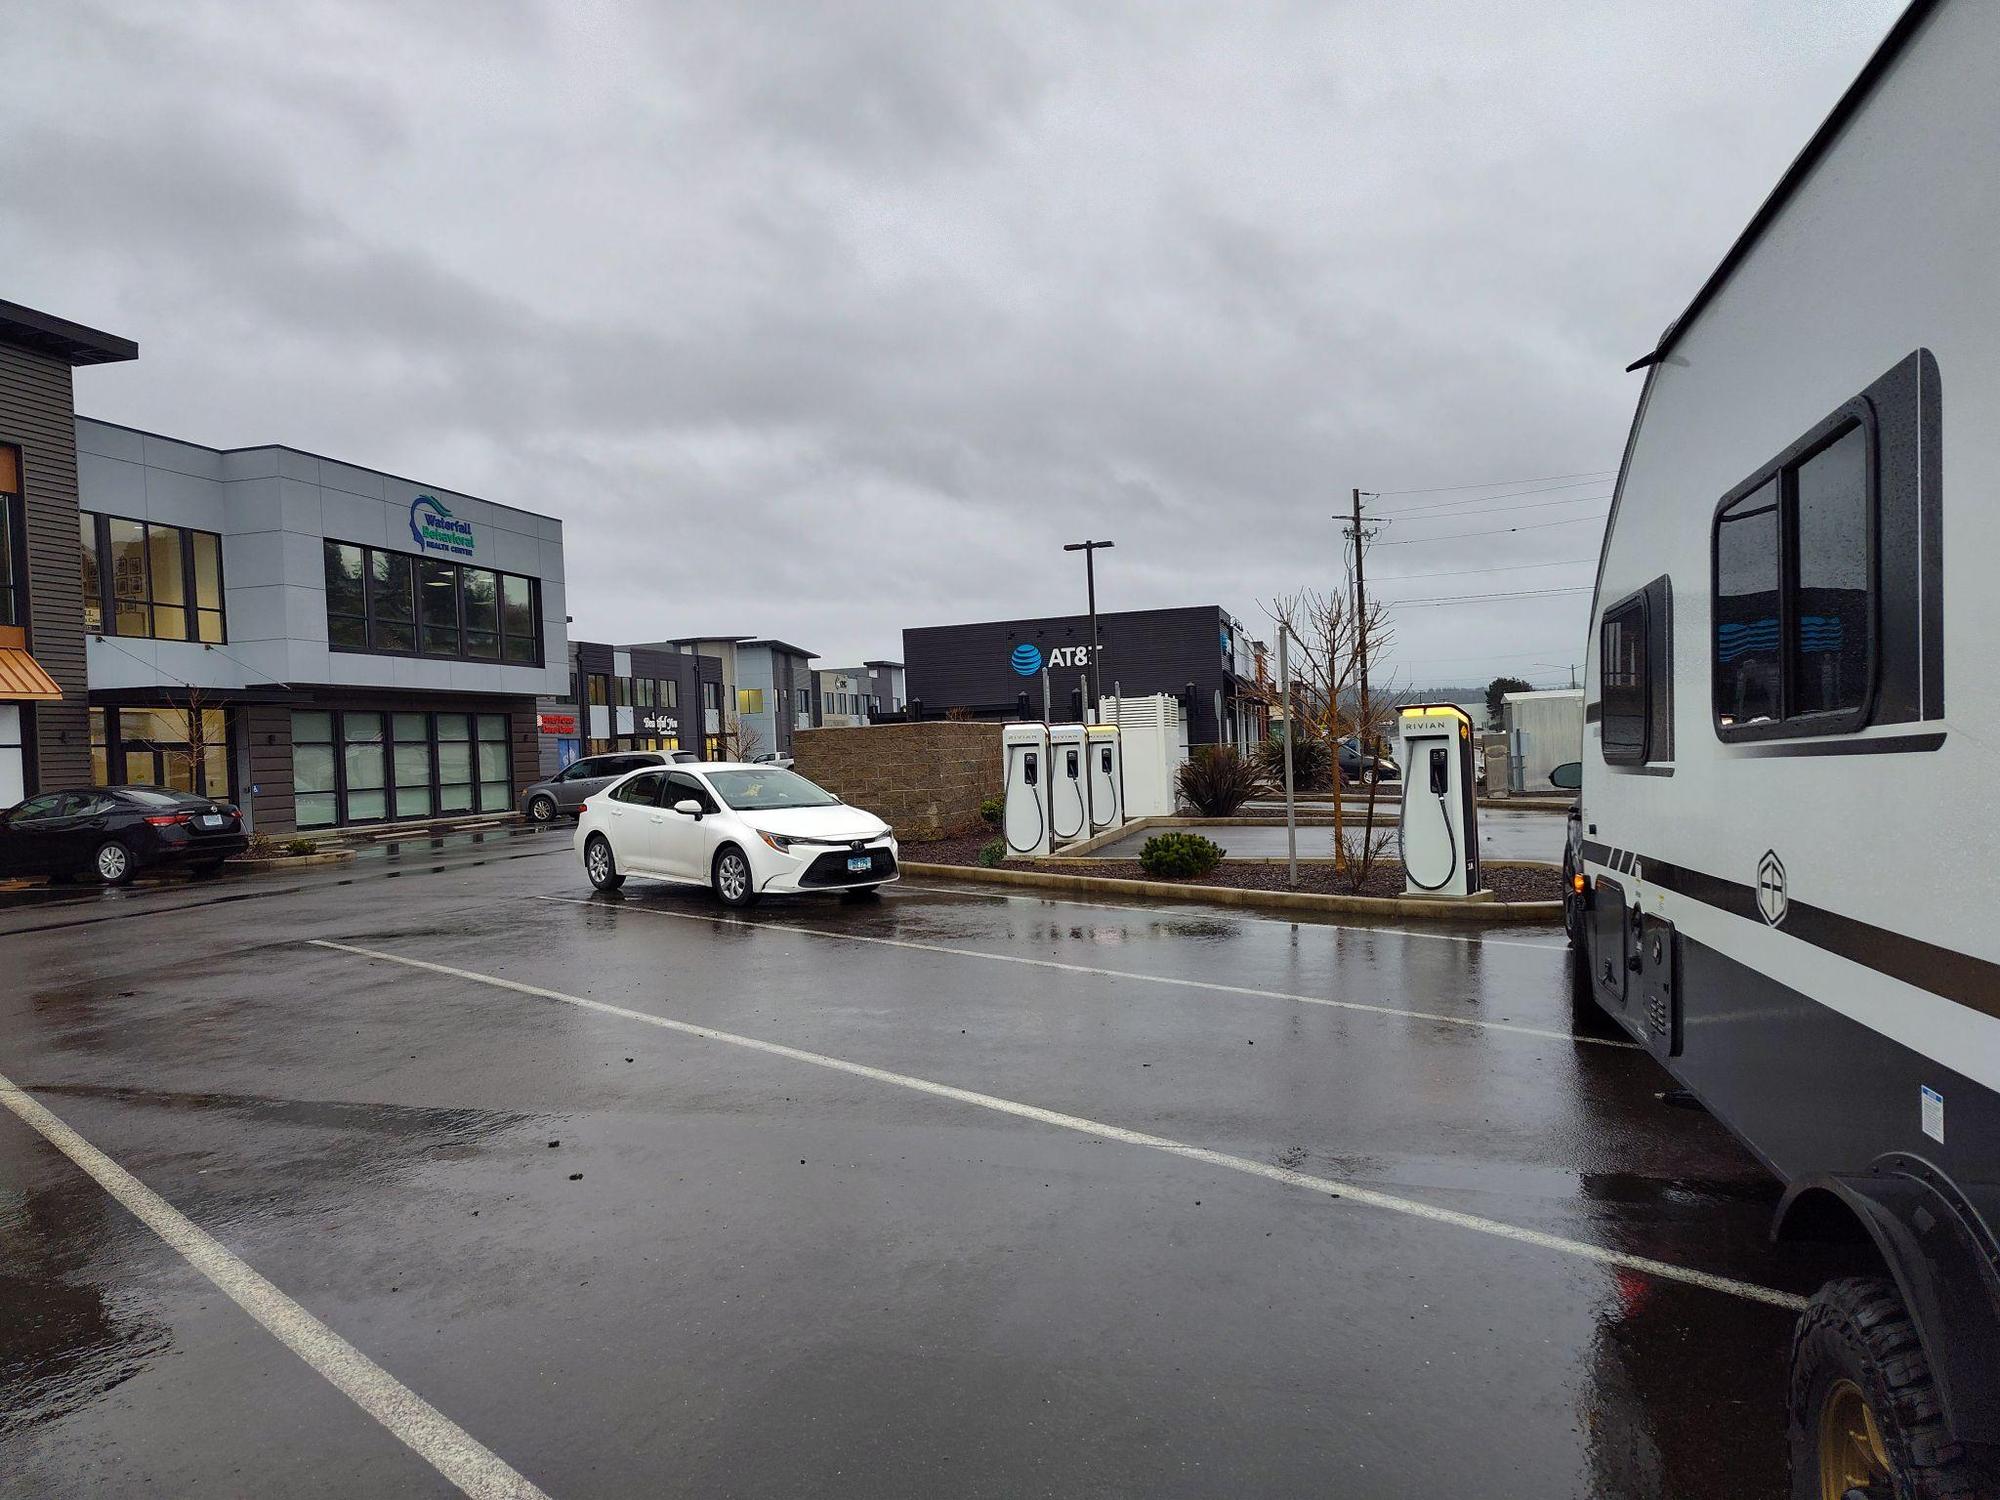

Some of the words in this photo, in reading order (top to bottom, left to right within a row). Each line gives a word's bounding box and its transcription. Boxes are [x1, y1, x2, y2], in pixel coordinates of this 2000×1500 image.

[424, 513, 472, 535] Waterfall
[422, 525, 475, 548] Behavioral
[426, 540, 449, 551] HEALTH
[450, 545, 473, 557] CENTER
[1405, 721, 1445, 730] RIVIAN
